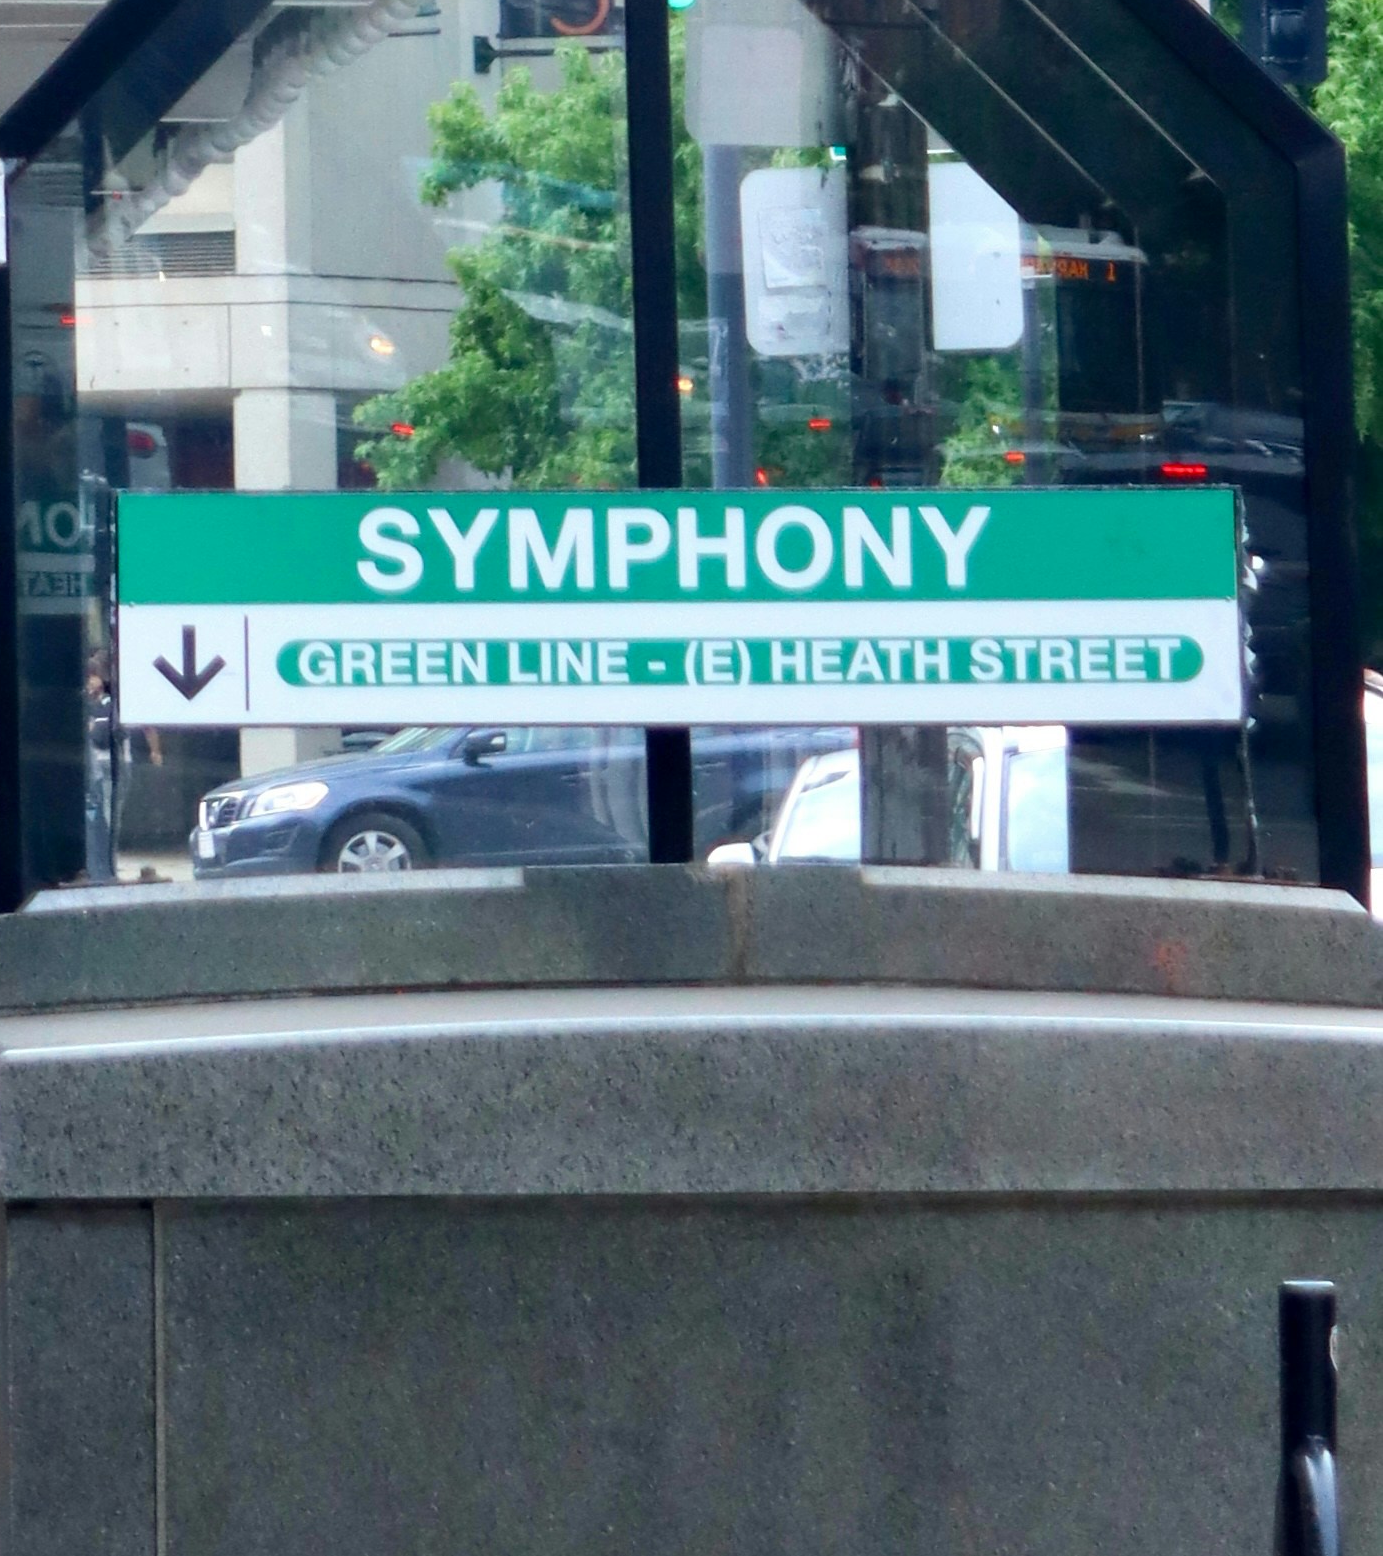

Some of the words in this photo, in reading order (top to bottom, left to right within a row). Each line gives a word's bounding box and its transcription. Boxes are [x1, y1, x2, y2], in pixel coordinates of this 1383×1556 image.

[356, 504, 992, 592] SYMPHONY
[297, 639, 489, 684] GREEN
[508, 640, 630, 684] LINE
[683, 638, 752, 688] (E)
[770, 638, 949, 682] HEATH
[969, 637, 1182, 681] STREET
